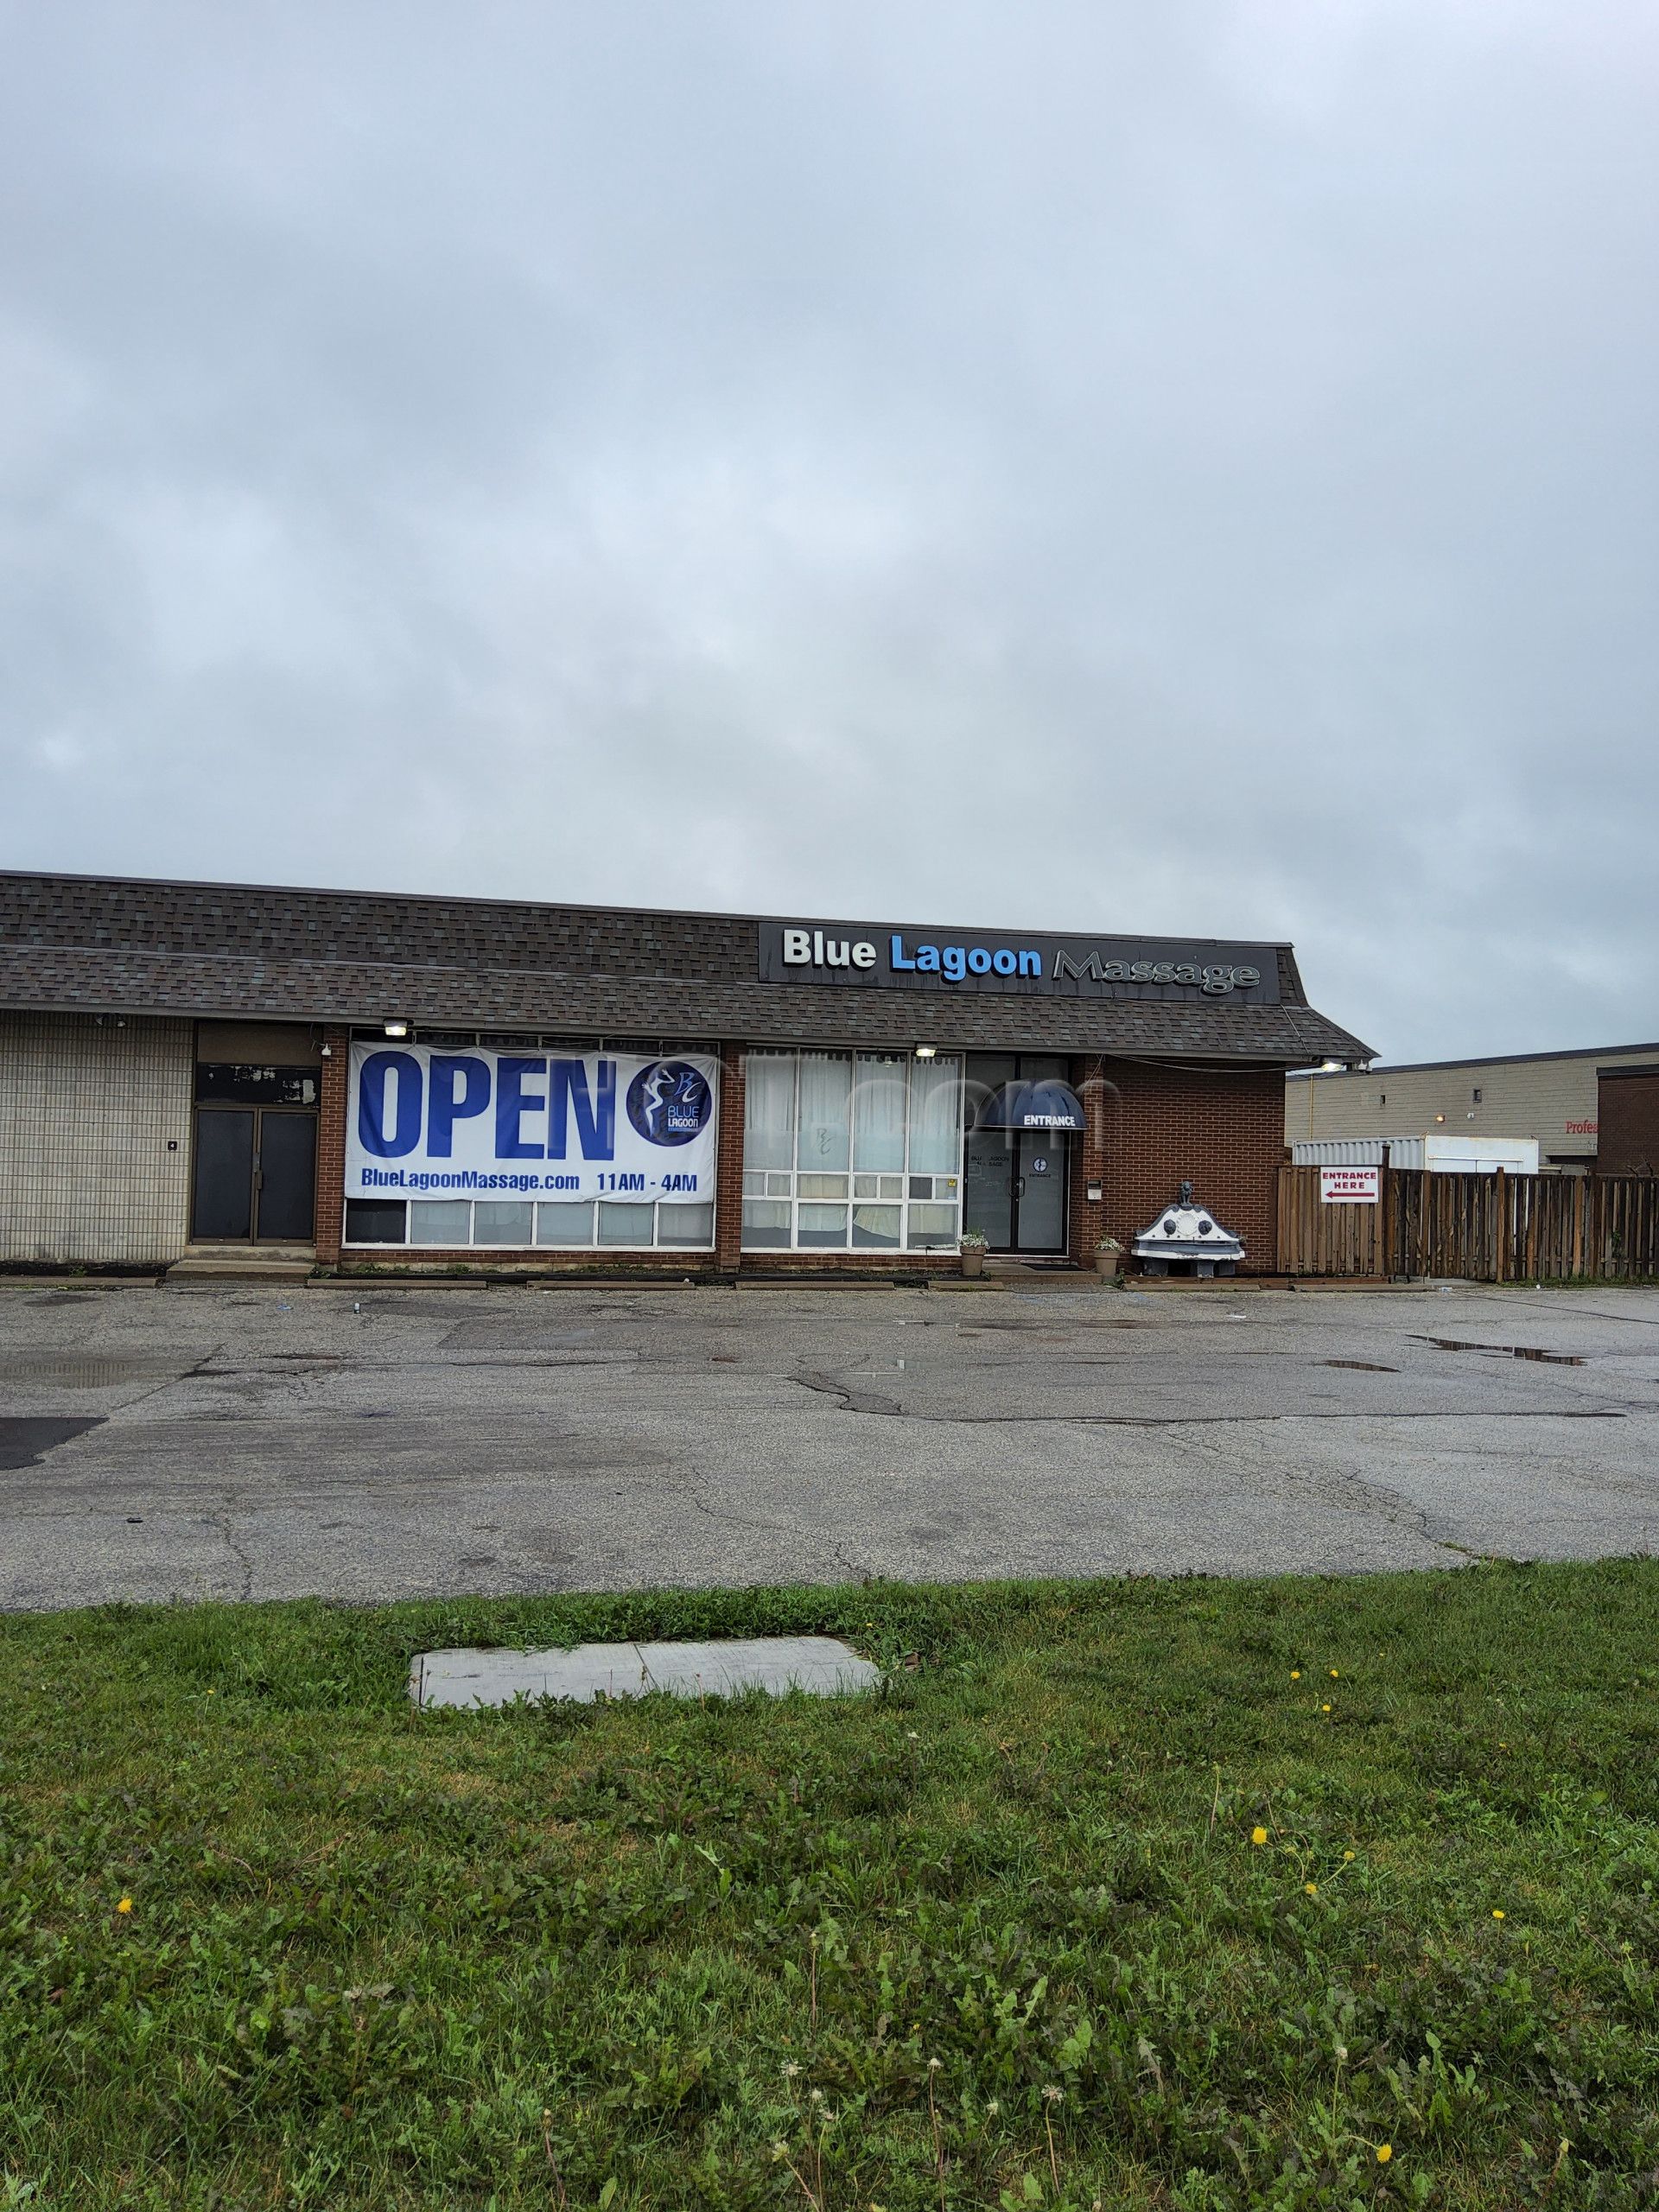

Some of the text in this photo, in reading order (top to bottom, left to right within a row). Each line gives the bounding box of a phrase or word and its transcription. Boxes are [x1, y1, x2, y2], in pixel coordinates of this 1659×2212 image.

[783, 929, 1261, 995] Blue Lagoon Massage
[359, 1050, 617, 1160] OPEN
[667, 1105, 700, 1118] BLUE
[667, 1118, 699, 1128] LAGOON
[1023, 1115, 1076, 1127] ENTRANCE
[361, 1167, 580, 1192] BlueLagoonMassage.com
[597, 1173, 645, 1192] 11AM
[661, 1174, 697, 1192] 4AM
